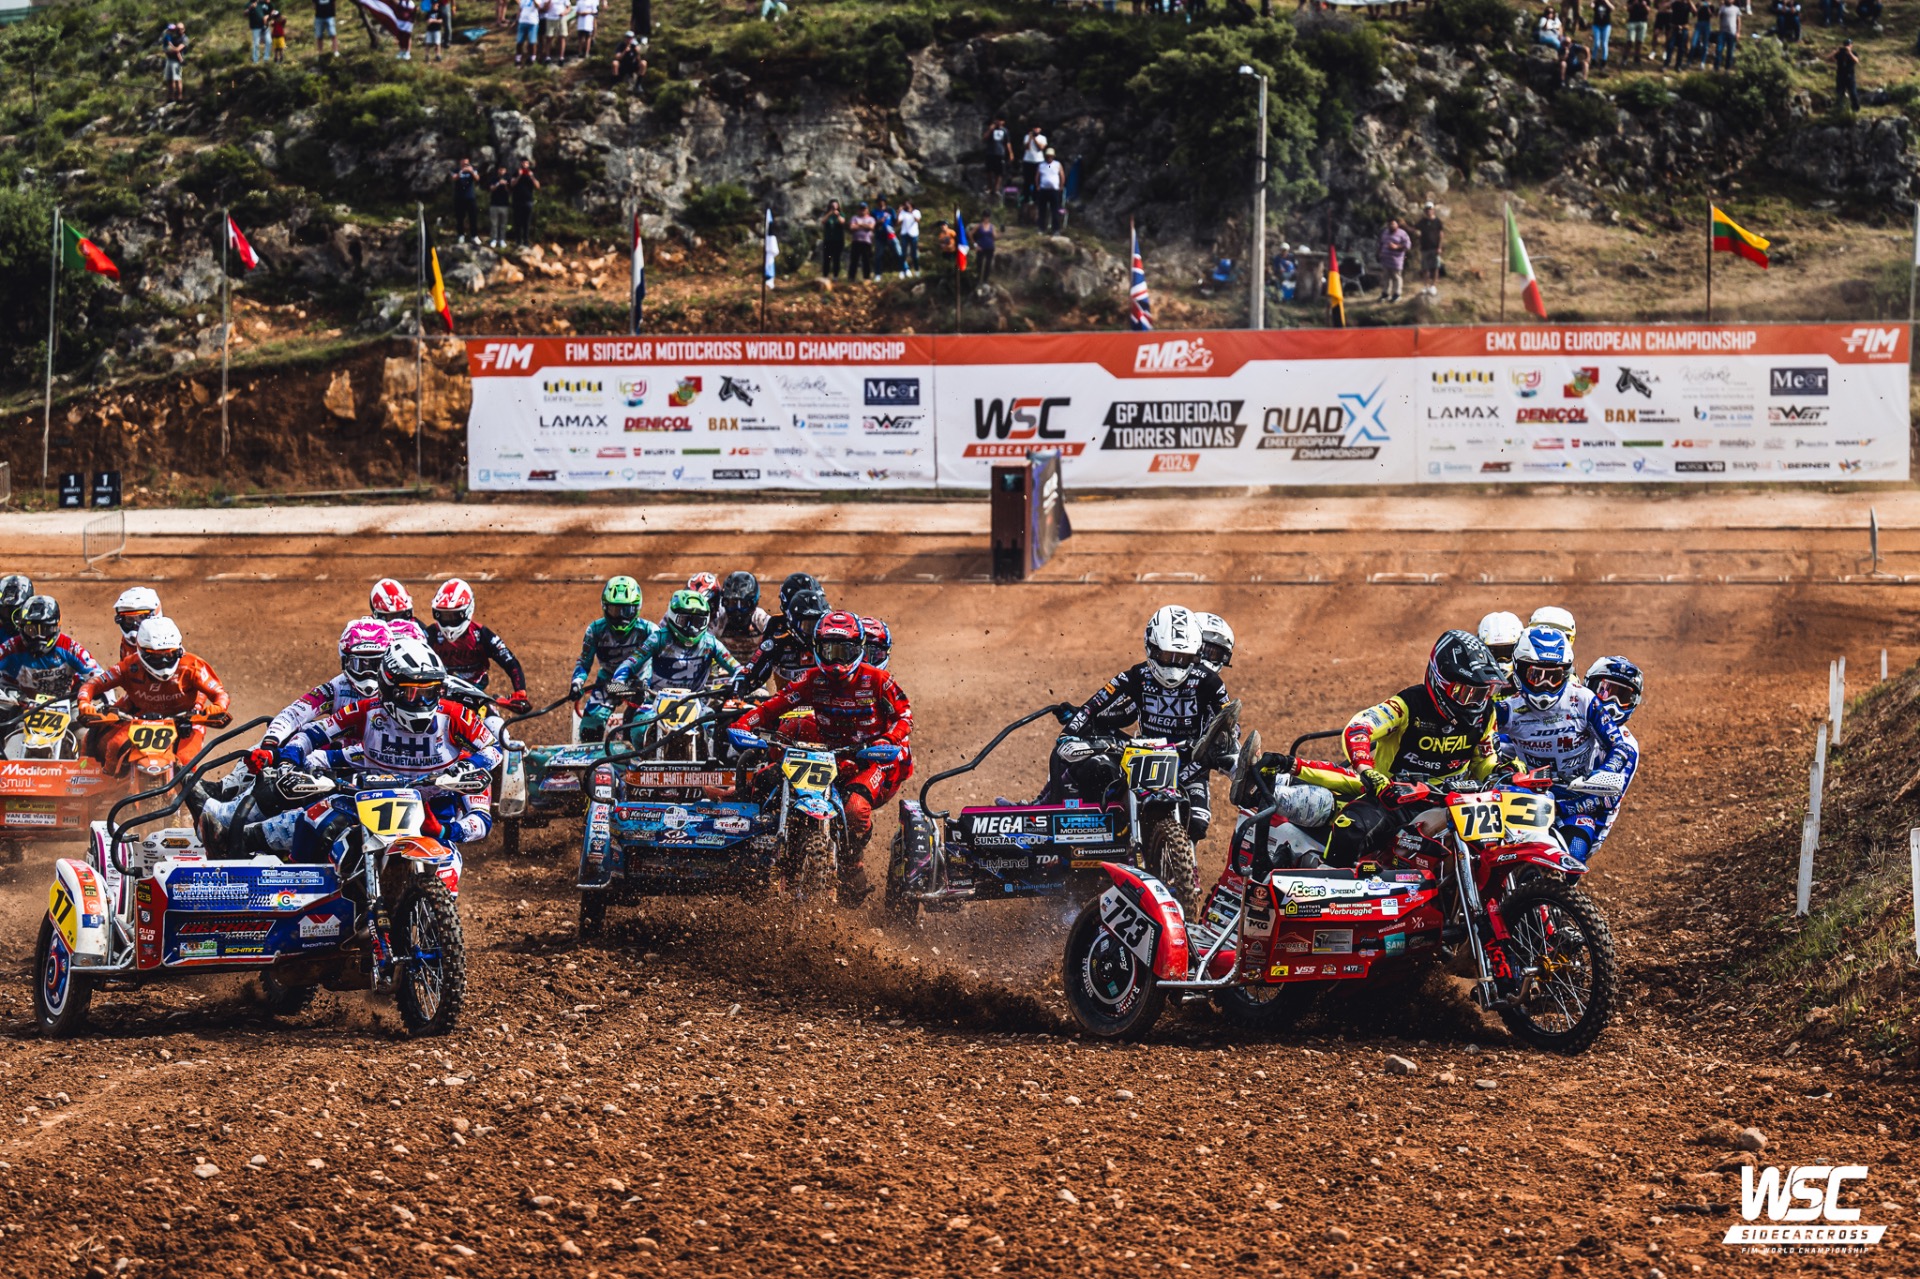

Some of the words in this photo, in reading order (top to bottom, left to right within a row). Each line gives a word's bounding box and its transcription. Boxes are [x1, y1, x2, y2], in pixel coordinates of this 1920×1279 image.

[1486, 331, 1517, 351] EMX
[1520, 331, 1561, 351] QUAD
[1565, 331, 1642, 350] EUROPEAN
[1645, 331, 1756, 350] CHAMPIONSHIP
[1841, 327, 1901, 353] FIM
[474, 343, 534, 370] FIM
[565, 342, 590, 361] FIM
[593, 342, 652, 361] SIDECAR
[656, 341, 742, 361] MOTOCROSS
[746, 341, 795, 360] WORLD
[799, 341, 906, 360] CHAMPIONSHIP
[1134, 340, 1189, 368] FMP
[539, 414, 608, 428] LAMAX
[974, 397, 1071, 440] WSC
[1116, 403, 1138, 424] GP
[1427, 406, 1499, 419] LAMAX
[1604, 409, 1637, 423] BAX
[708, 417, 739, 431] BAX
[1113, 428, 1176, 449] TORRES
[1180, 426, 1235, 447] NOVAS
[1264, 438, 1286, 449] EMX
[1287, 437, 1340, 448] EUROPEAN
[1299, 447, 1375, 459] CHAMPIONSHIP
[1158, 454, 1191, 471] 2024
[69, 475, 75, 487] 1
[102, 474, 109, 487] 1
[1142, 692, 1198, 717] FXR
[1148, 715, 1177, 728] MEGA
[133, 727, 174, 750] 98
[1530, 727, 1577, 737] JOPA
[1419, 735, 1472, 754] O'NEAL
[1, 763, 62, 776] Modiform
[789, 761, 832, 787] 75
[1127, 755, 1179, 789] 101
[371, 801, 419, 831] 17
[630, 810, 662, 819] Kendall
[1460, 804, 1503, 837] 723
[1506, 797, 1552, 828] 3
[972, 816, 1023, 834] MEGA
[974, 836, 1016, 846] SUNSTAR
[1017, 836, 1048, 845] GROUP
[1036, 854, 1059, 864] TDA
[1287, 881, 1327, 898] Æcars
[51, 889, 72, 925] 17
[1329, 908, 1373, 916] Verbrugghe
[1103, 895, 1149, 948] 723
